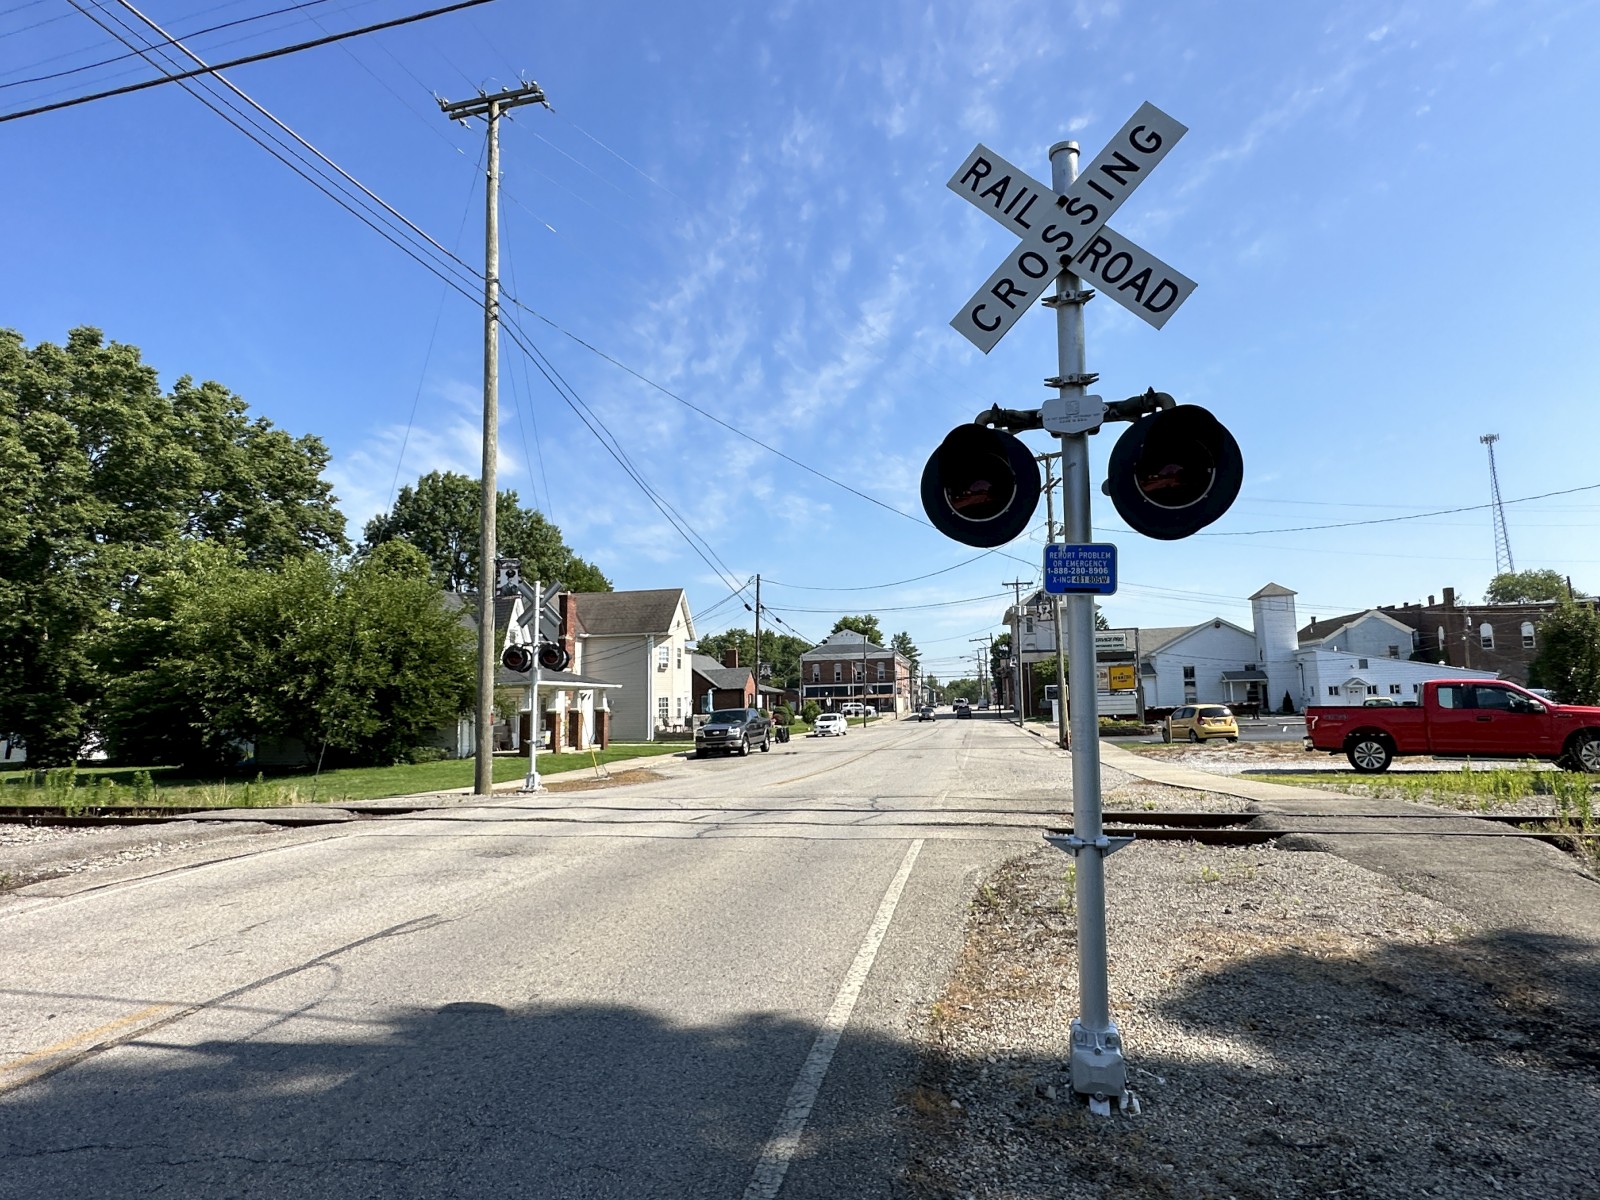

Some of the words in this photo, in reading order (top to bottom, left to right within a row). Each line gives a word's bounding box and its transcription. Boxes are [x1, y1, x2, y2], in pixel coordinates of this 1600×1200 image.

[971, 125, 1163, 333] CROSSING
[960, 157, 1039, 229] RAIL
[1077, 236, 1179, 313] ROAD
[1049, 551, 1076, 559] REPORT
[1078, 551, 1111, 559] PROBLEM
[1052, 559, 1063, 567] OR
[1065, 559, 1108, 567] EMERGENCY
[1046, 567, 1109, 575] 1-888-280-8906
[1052, 576, 1071, 584] X-ING
